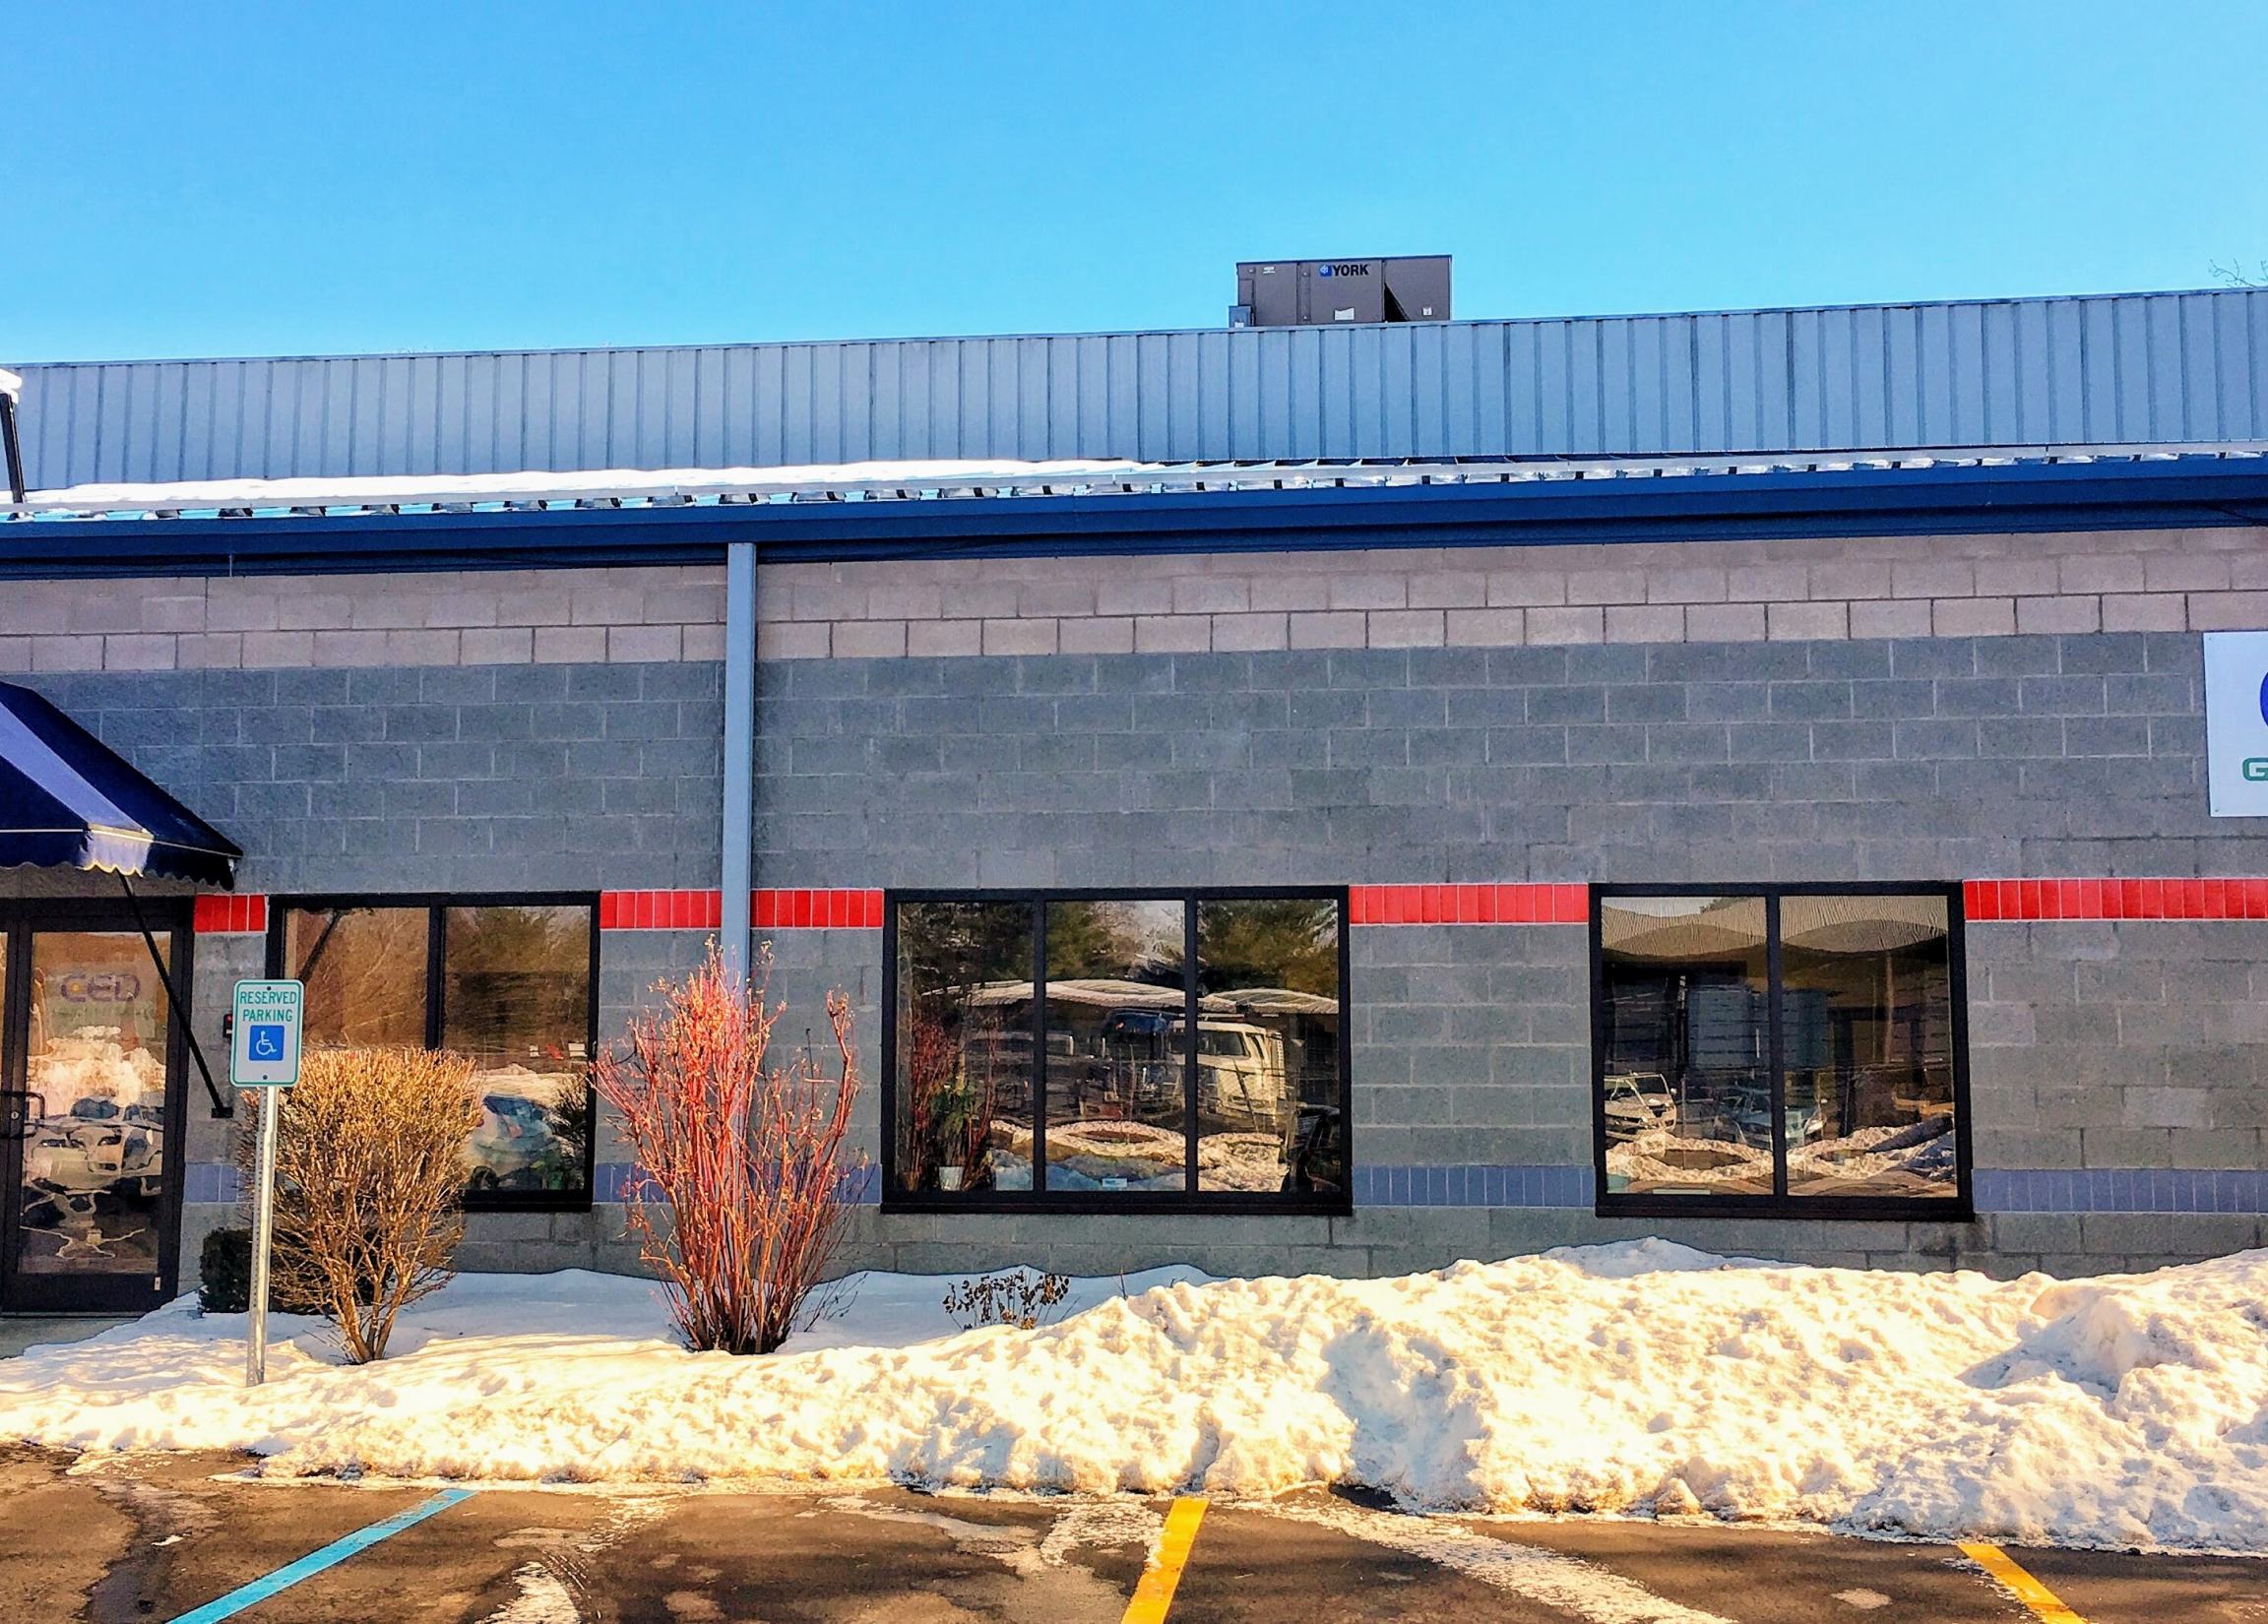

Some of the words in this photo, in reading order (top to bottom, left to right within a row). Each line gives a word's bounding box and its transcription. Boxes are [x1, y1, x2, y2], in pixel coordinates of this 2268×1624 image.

[1332, 264, 1369, 277] YORK
[240, 991, 297, 1004] RESERVED
[242, 1009, 292, 1022] PARKING
